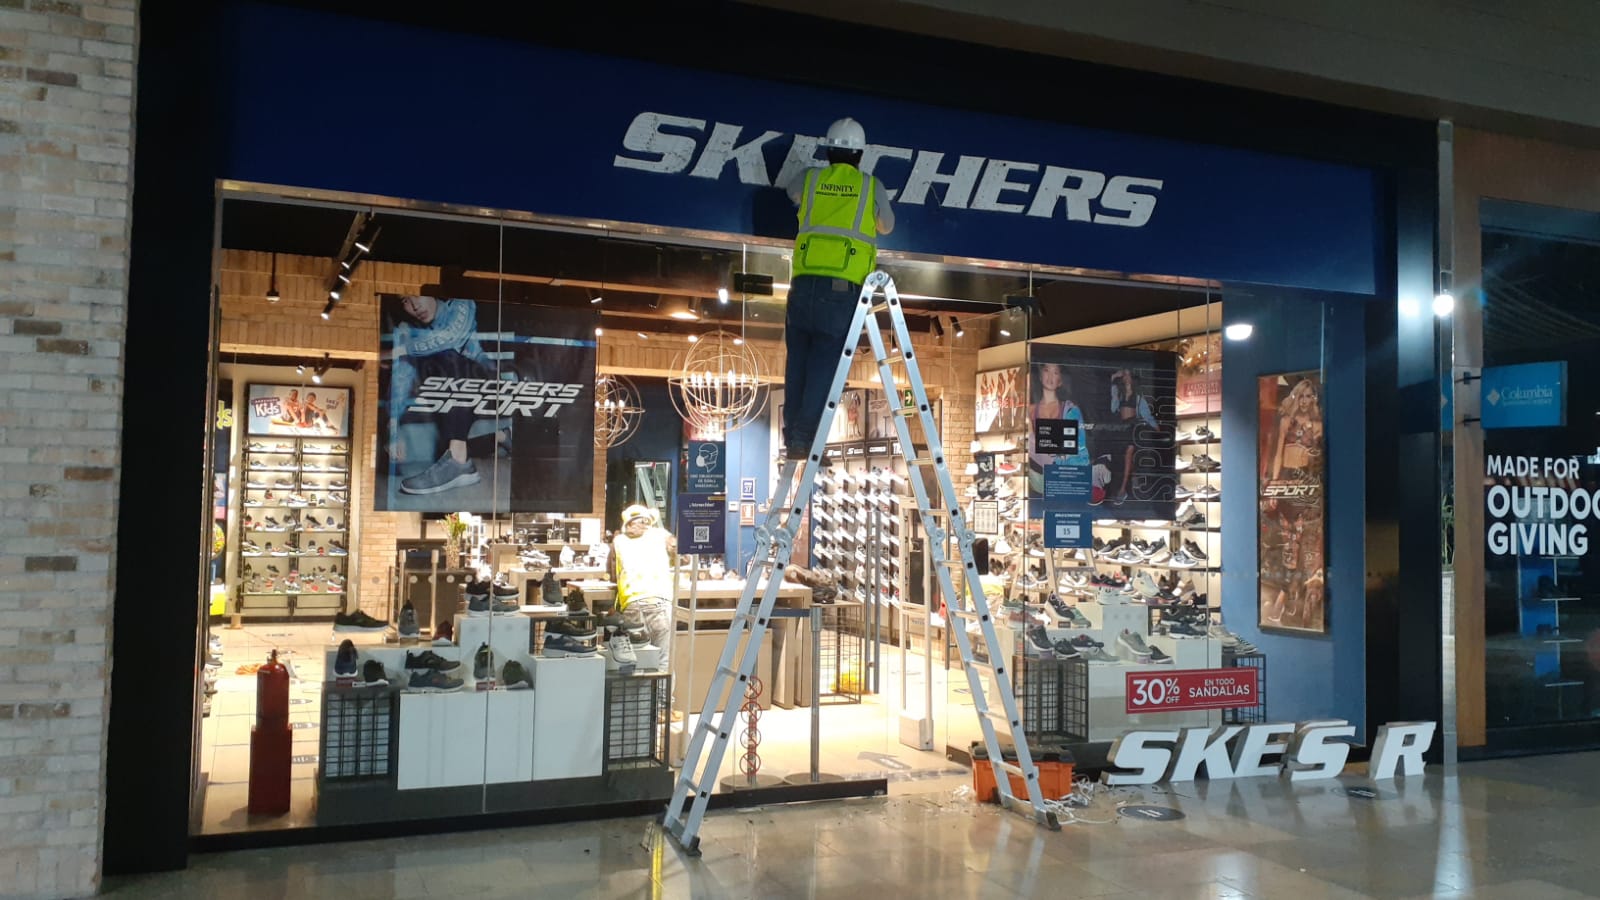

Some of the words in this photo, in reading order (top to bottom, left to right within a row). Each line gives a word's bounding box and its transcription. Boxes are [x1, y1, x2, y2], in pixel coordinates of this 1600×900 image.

[820, 183, 854, 192] INFINITY
[419, 376, 584, 397] SKECHERS
[1500, 384, 1553, 400] Columbia
[255, 403, 280, 417] Kids
[408, 392, 576, 418] SPORT
[1487, 455, 1539, 477] MADE
[1544, 457, 1580, 479] FOR
[1263, 484, 1320, 496] SPORT
[1487, 522, 1588, 556] GIVING
[1132, 678, 1180, 706] 30%
[1188, 684, 1250, 698] SANDALIAS
[1370, 721, 1437, 781] R
